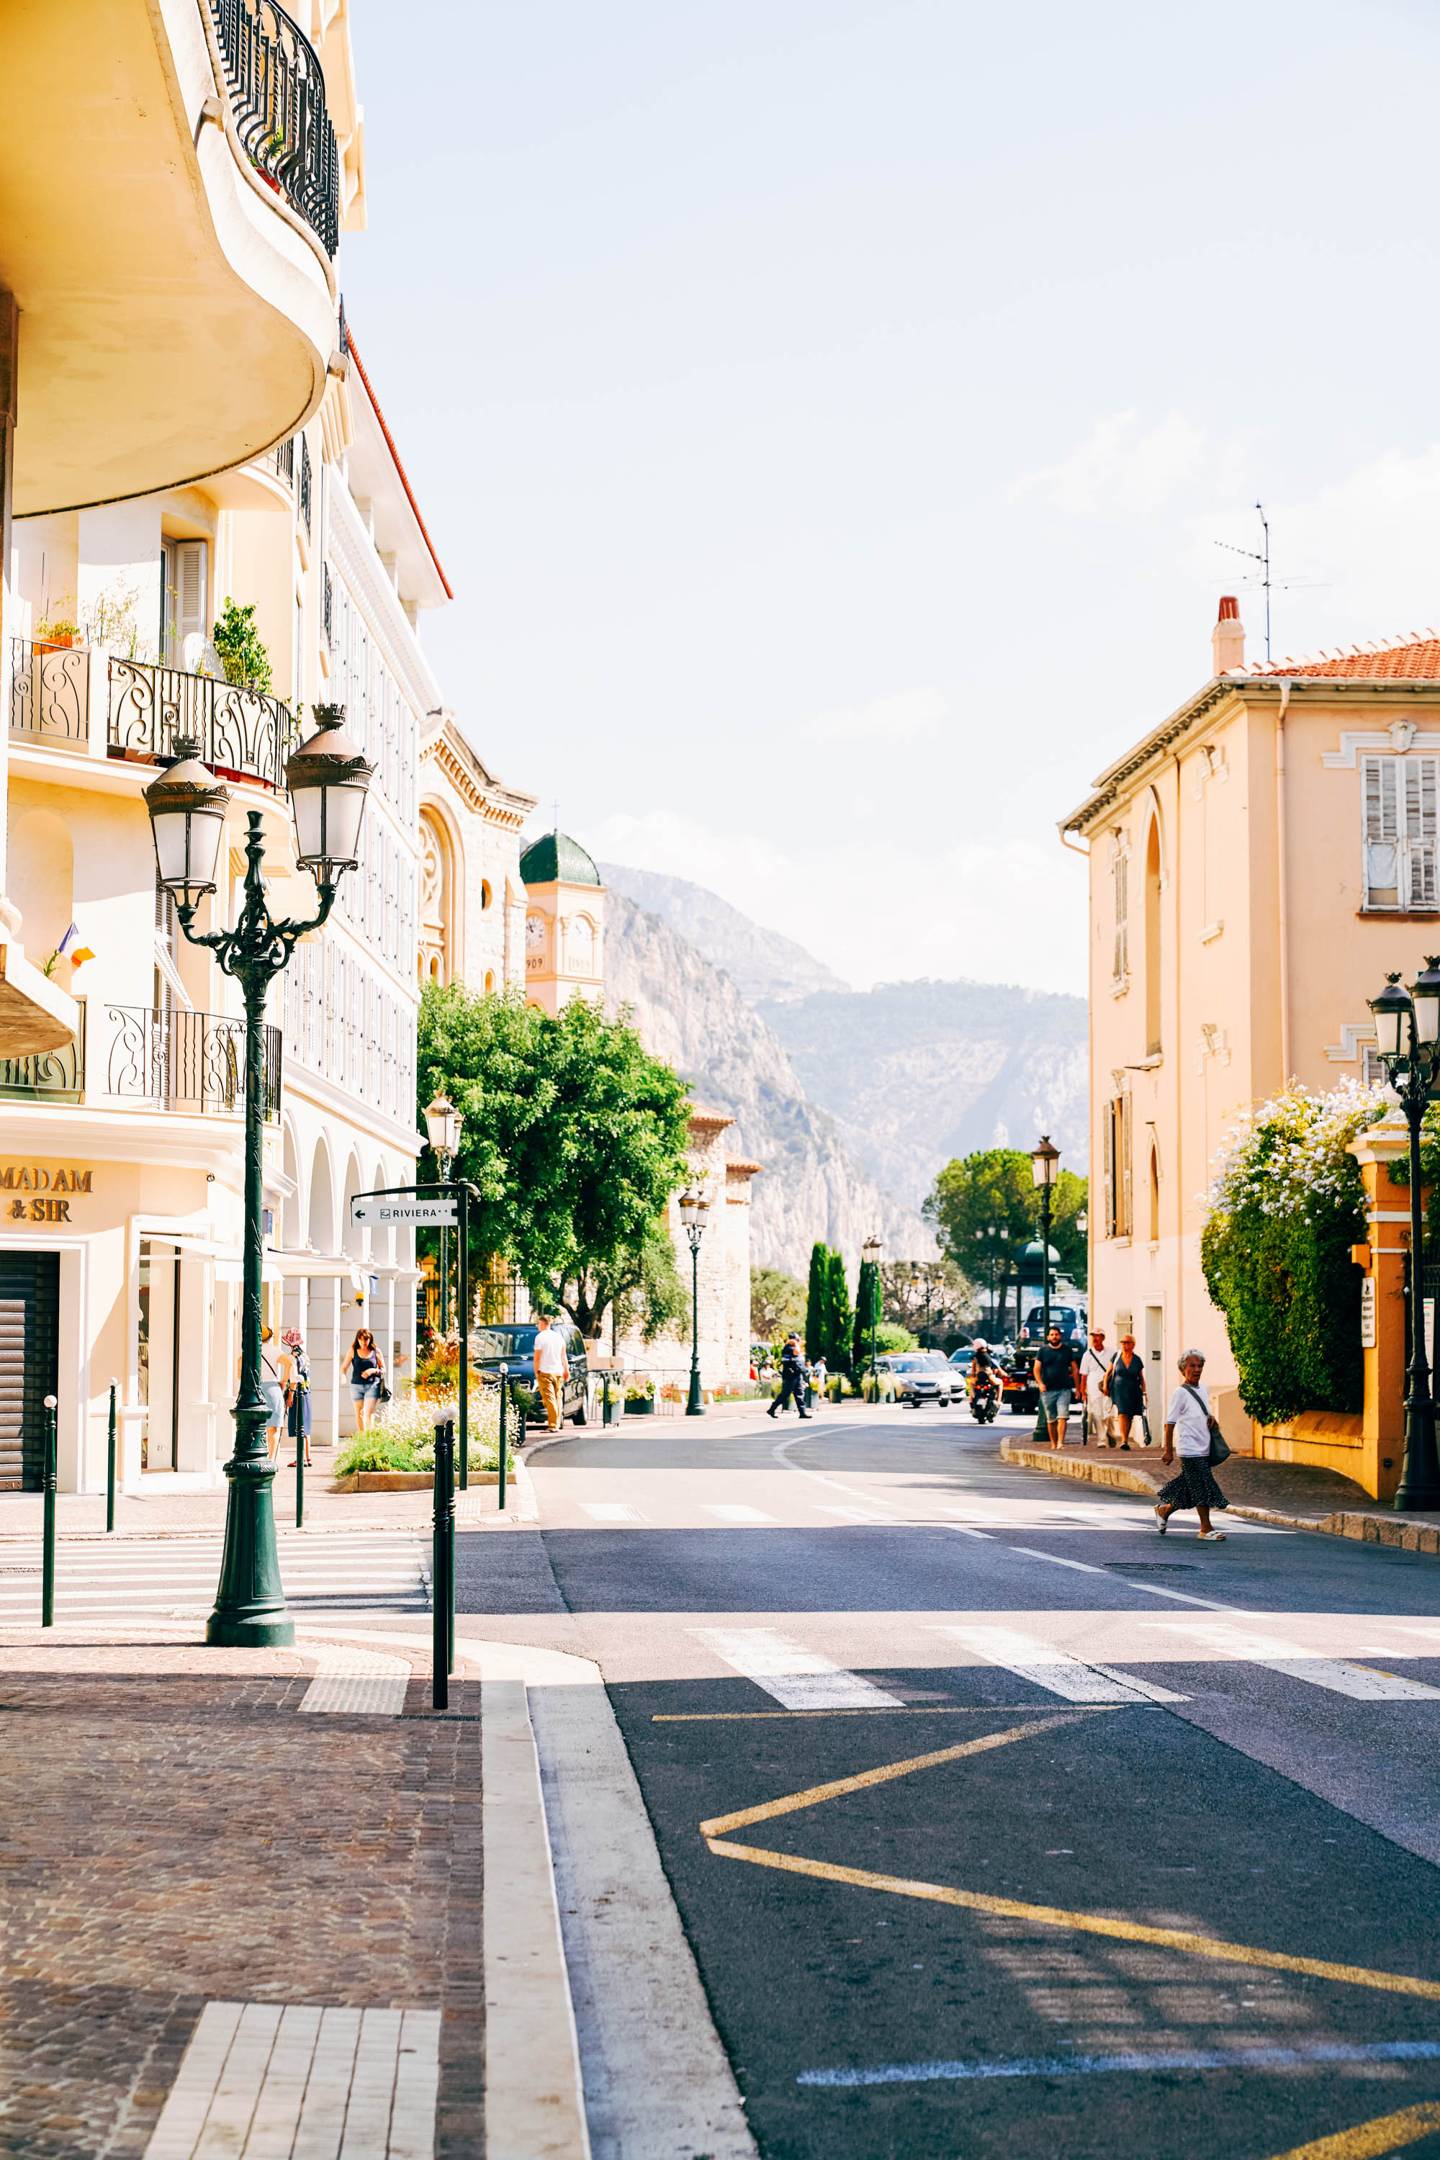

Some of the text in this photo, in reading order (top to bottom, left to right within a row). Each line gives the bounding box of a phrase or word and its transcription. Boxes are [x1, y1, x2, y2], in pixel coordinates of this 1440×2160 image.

[0, 1167, 94, 1192] MADAM
[9, 1198, 72, 1222] & SIR
